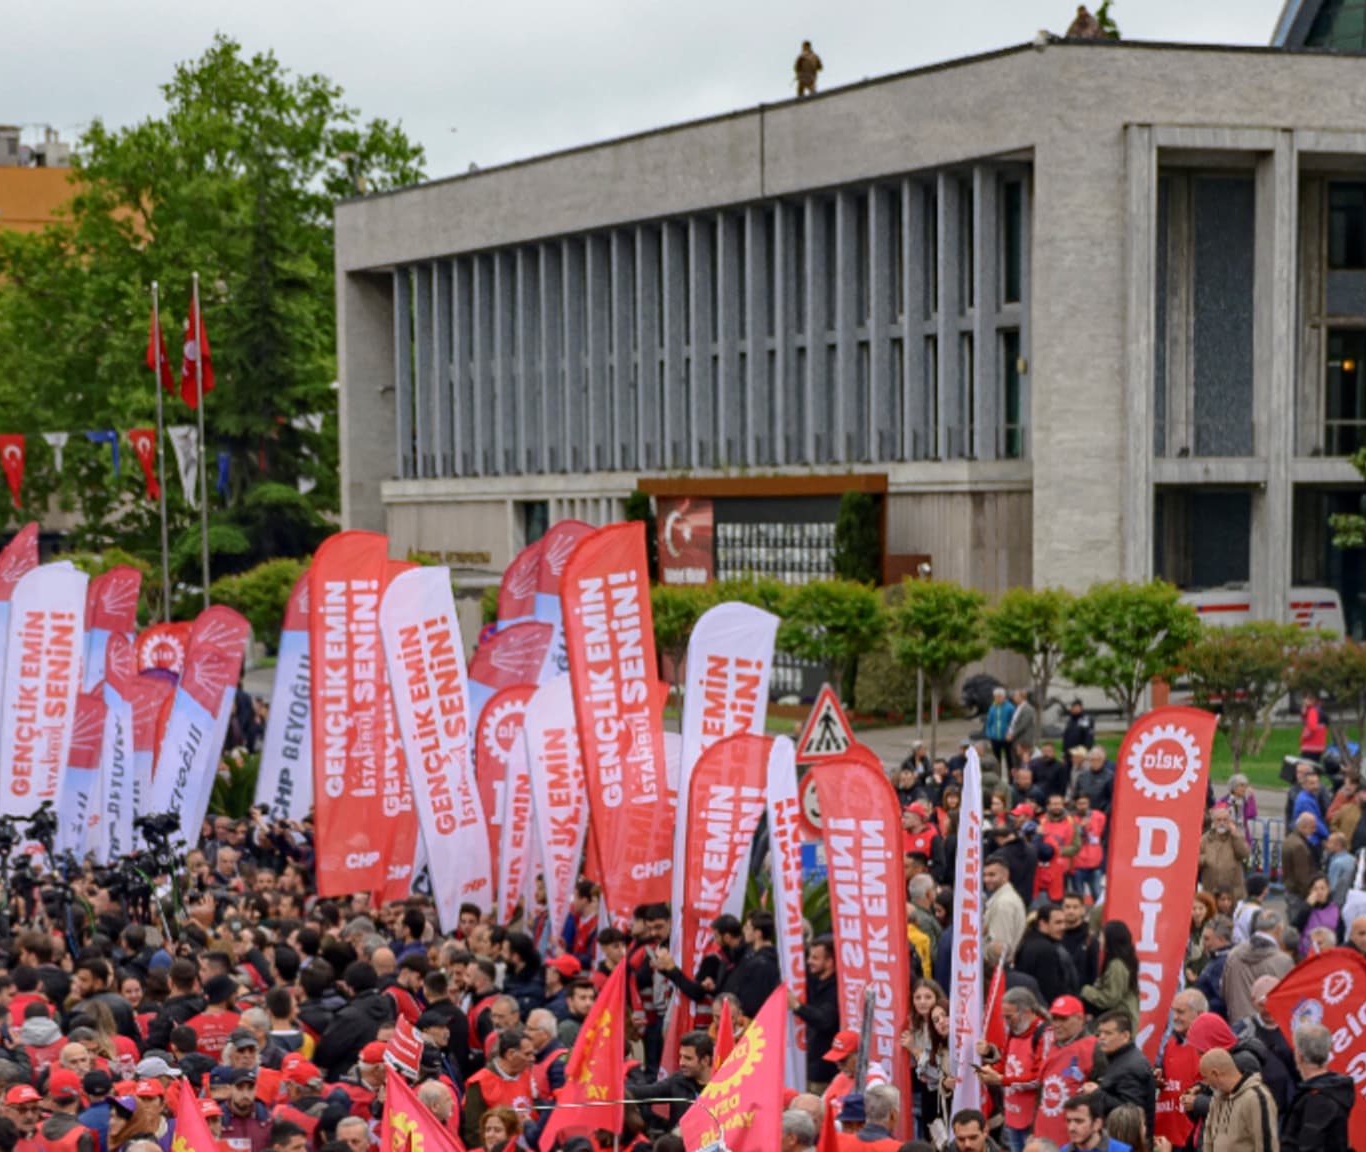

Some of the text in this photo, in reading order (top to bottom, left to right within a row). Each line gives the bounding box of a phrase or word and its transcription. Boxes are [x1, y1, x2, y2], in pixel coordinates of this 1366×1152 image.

[44, 611, 76, 718] SENİN!
[319, 581, 351, 798] GENÇLİK EMİN
[350, 579, 379, 699] SENİN!
[423, 614, 467, 738] SENİN!
[575, 577, 625, 808] GENÇLİK EMİN
[608, 570, 648, 705] SENİN!
[11, 611, 46, 798] GENÇLİK EMİN
[397, 624, 457, 836] GENÇLİK EMİN
[1142, 749, 1185, 772] DİSK
[539, 728, 571, 812] EMİN
[704, 785, 736, 872] EMİN
[346, 851, 380, 869] CHP
[631, 860, 672, 881] CHP
